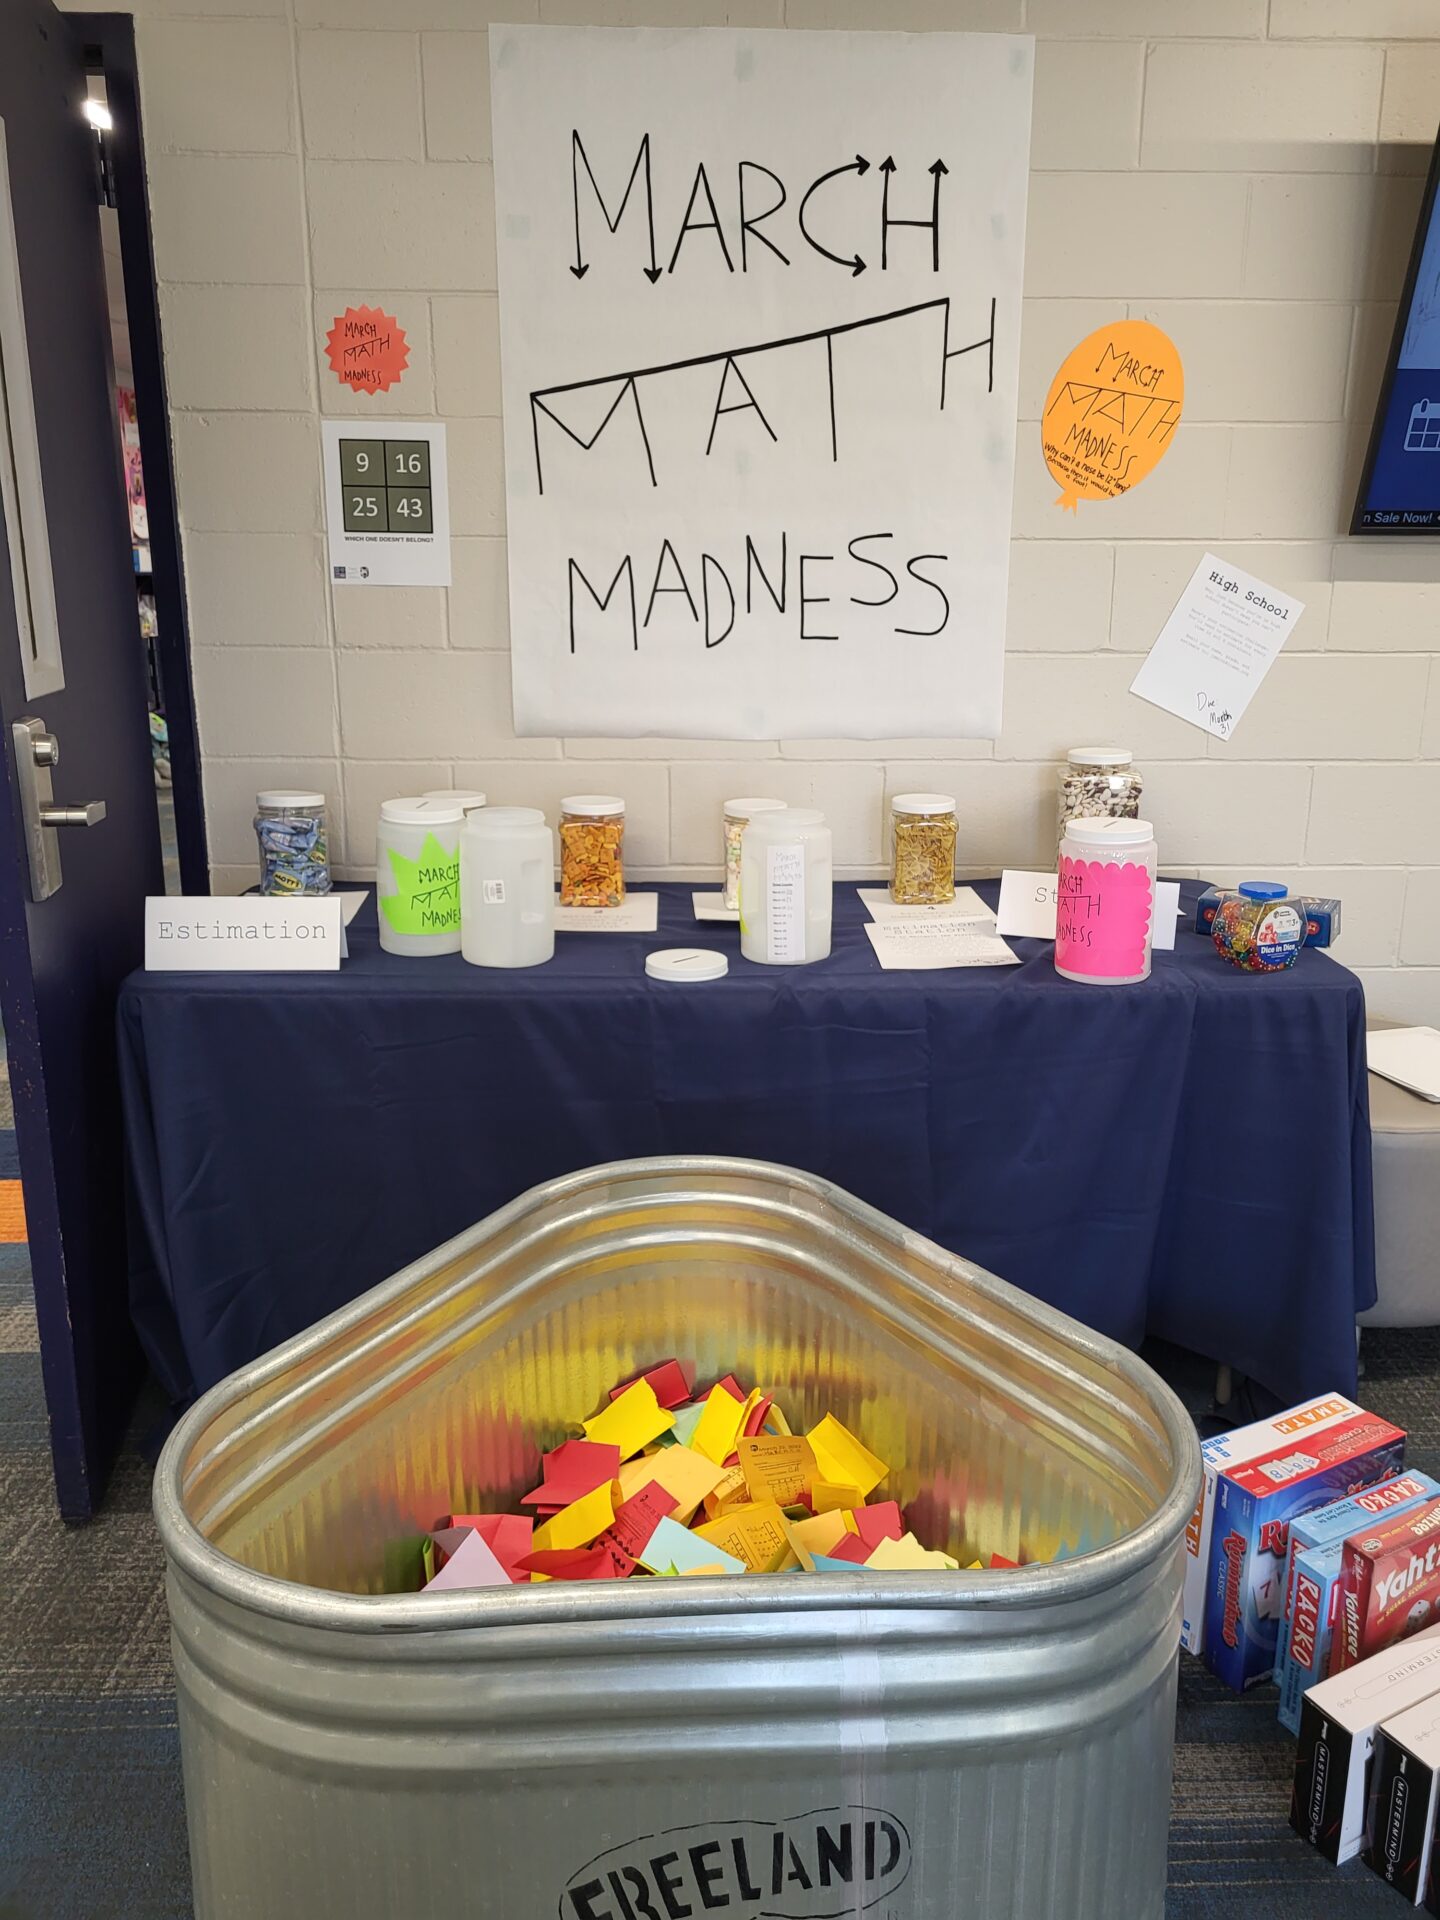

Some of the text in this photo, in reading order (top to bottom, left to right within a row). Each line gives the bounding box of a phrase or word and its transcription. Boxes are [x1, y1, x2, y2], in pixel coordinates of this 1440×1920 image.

[569, 129, 949, 284] MARCH
[345, 321, 377, 339] MARCH
[344, 333, 390, 366] MATH
[1095, 342, 1165, 392] MARCH
[344, 368, 381, 385] MADNESS
[530, 297, 996, 494] MATH
[1047, 381, 1181, 443] MATH
[355, 452, 421, 474] 9 16
[1045, 442, 1059, 457] Why
[1081, 463, 1097, 475] nose
[1097, 470, 1105, 480] be
[1064, 423, 1138, 480] MADNESS
[352, 497, 423, 518] 25 43
[1374, 512, 1400, 523] Sale
[1402, 512, 1433, 524] Now!
[569, 531, 950, 654] MADNESS
[1208, 571, 1239, 594] High
[1245, 591, 1290, 620] School
[1197, 692, 1215, 711] Due
[1220, 722, 1230, 734] 31
[418, 862, 460, 884] MARCH
[158, 920, 326, 940] Estimation
[1261, 946, 1275, 954] Dice
[1276, 944, 1283, 953] in
[1275, 1402, 1344, 1433] SMATH
[1217, 1561, 1225, 1599] CLASSIC
[1260, 1579, 1272, 1599] 7
[1343, 1589, 1360, 1658] Yahtzee
[1312, 1746, 1327, 1824] MASTERMIND
[1389, 1780, 1406, 1859] MASTERMIND
[568, 1820, 901, 1920] FREELAND
